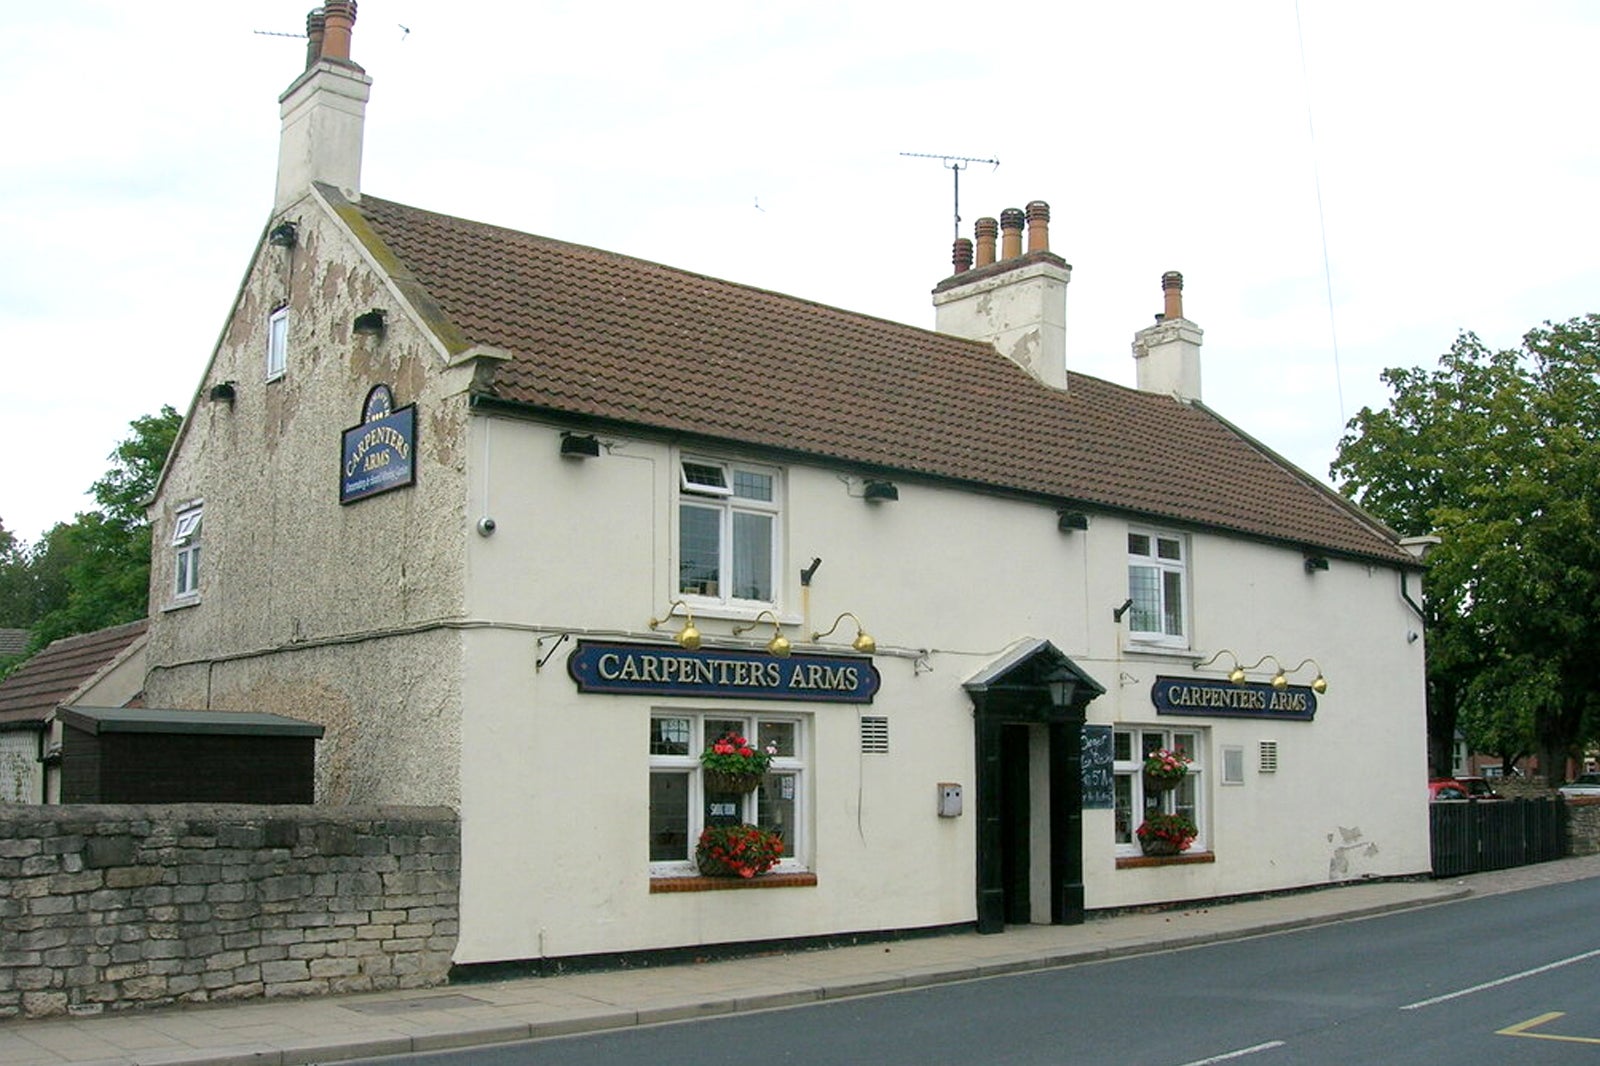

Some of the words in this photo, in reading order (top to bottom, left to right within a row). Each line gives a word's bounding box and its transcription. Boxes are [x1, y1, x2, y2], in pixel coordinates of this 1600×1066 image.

[346, 427, 409, 477] CARPENTERS
[363, 449, 390, 472] ARMS
[598, 654, 781, 687] CARPENTERS
[789, 665, 859, 691] ARMS
[1168, 685, 1266, 709] CARPENTERS
[1269, 692, 1307, 711] ARMS
